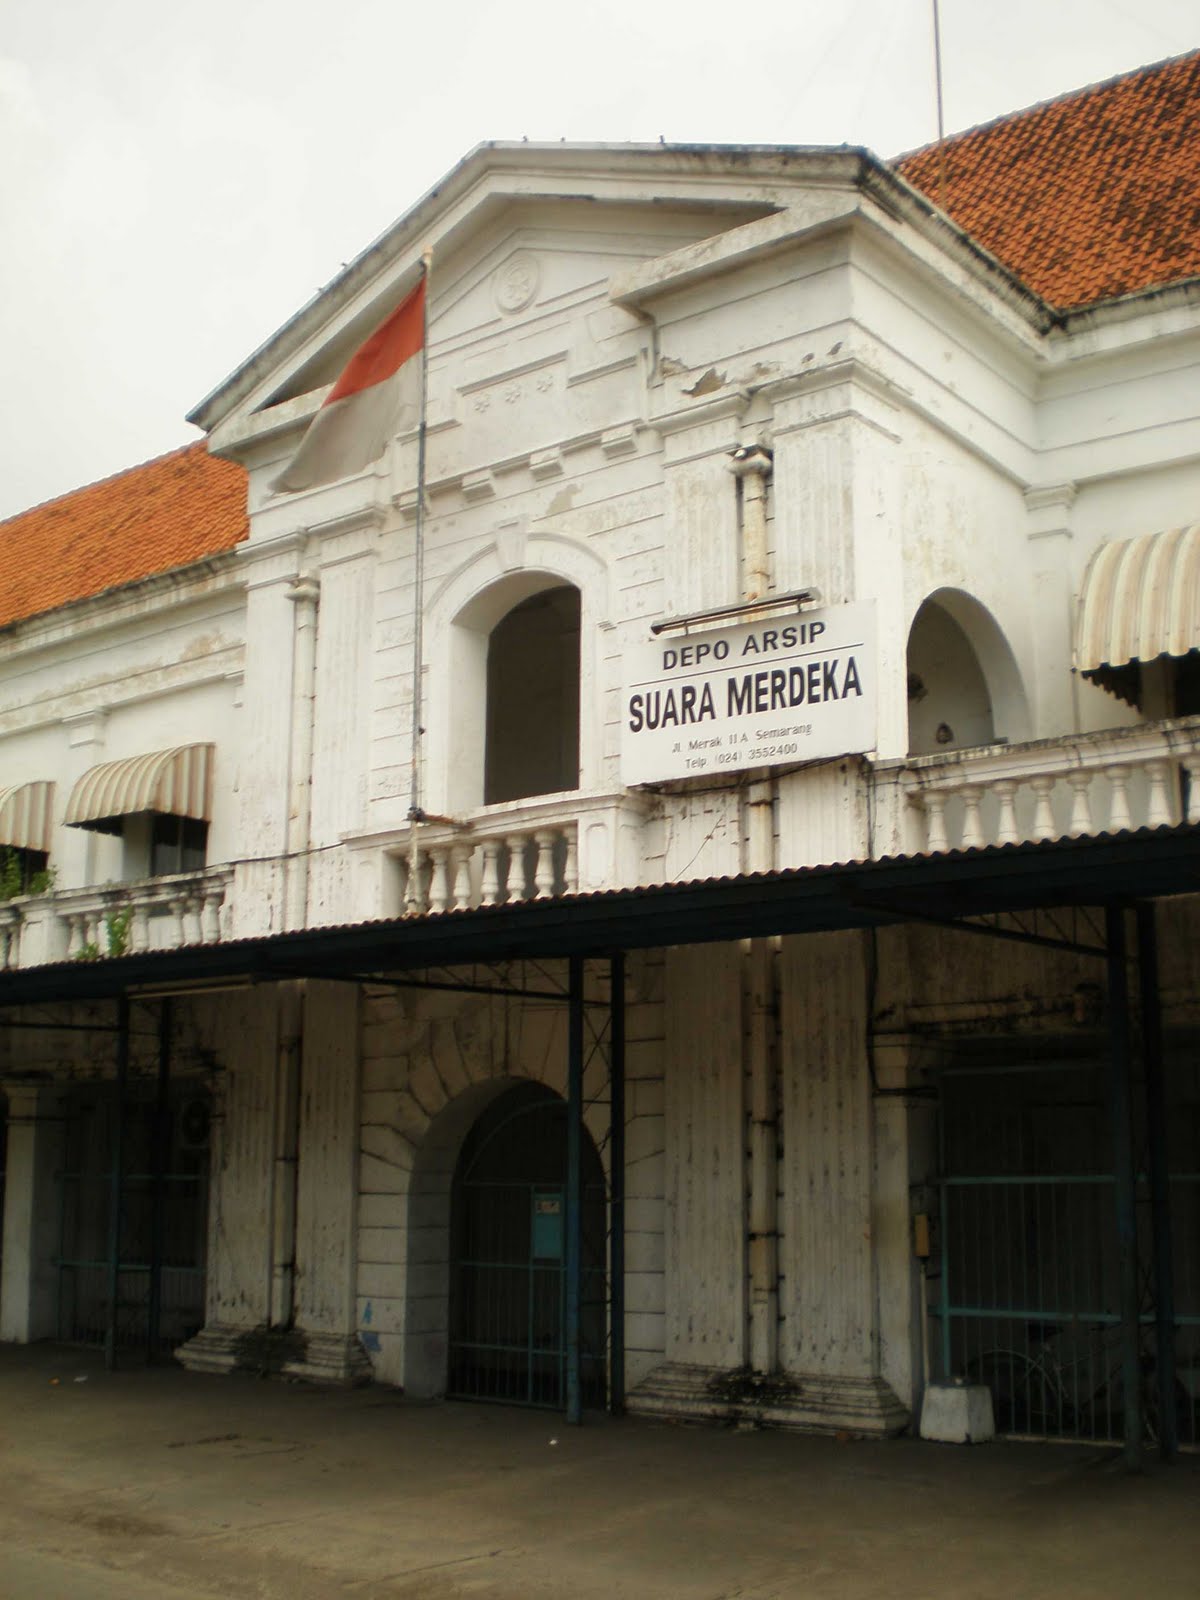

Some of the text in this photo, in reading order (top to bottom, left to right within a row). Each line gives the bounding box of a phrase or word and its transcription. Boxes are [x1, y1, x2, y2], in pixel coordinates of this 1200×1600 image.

[663, 621, 826, 670] DEPO ARSIP
[629, 656, 863, 733] SUARA MERDEKA
[688, 736, 723, 751] Merak
[755, 724, 813, 740] Semarang
[714, 750, 743, 765] (024)
[748, 743, 797, 760] 3552400
